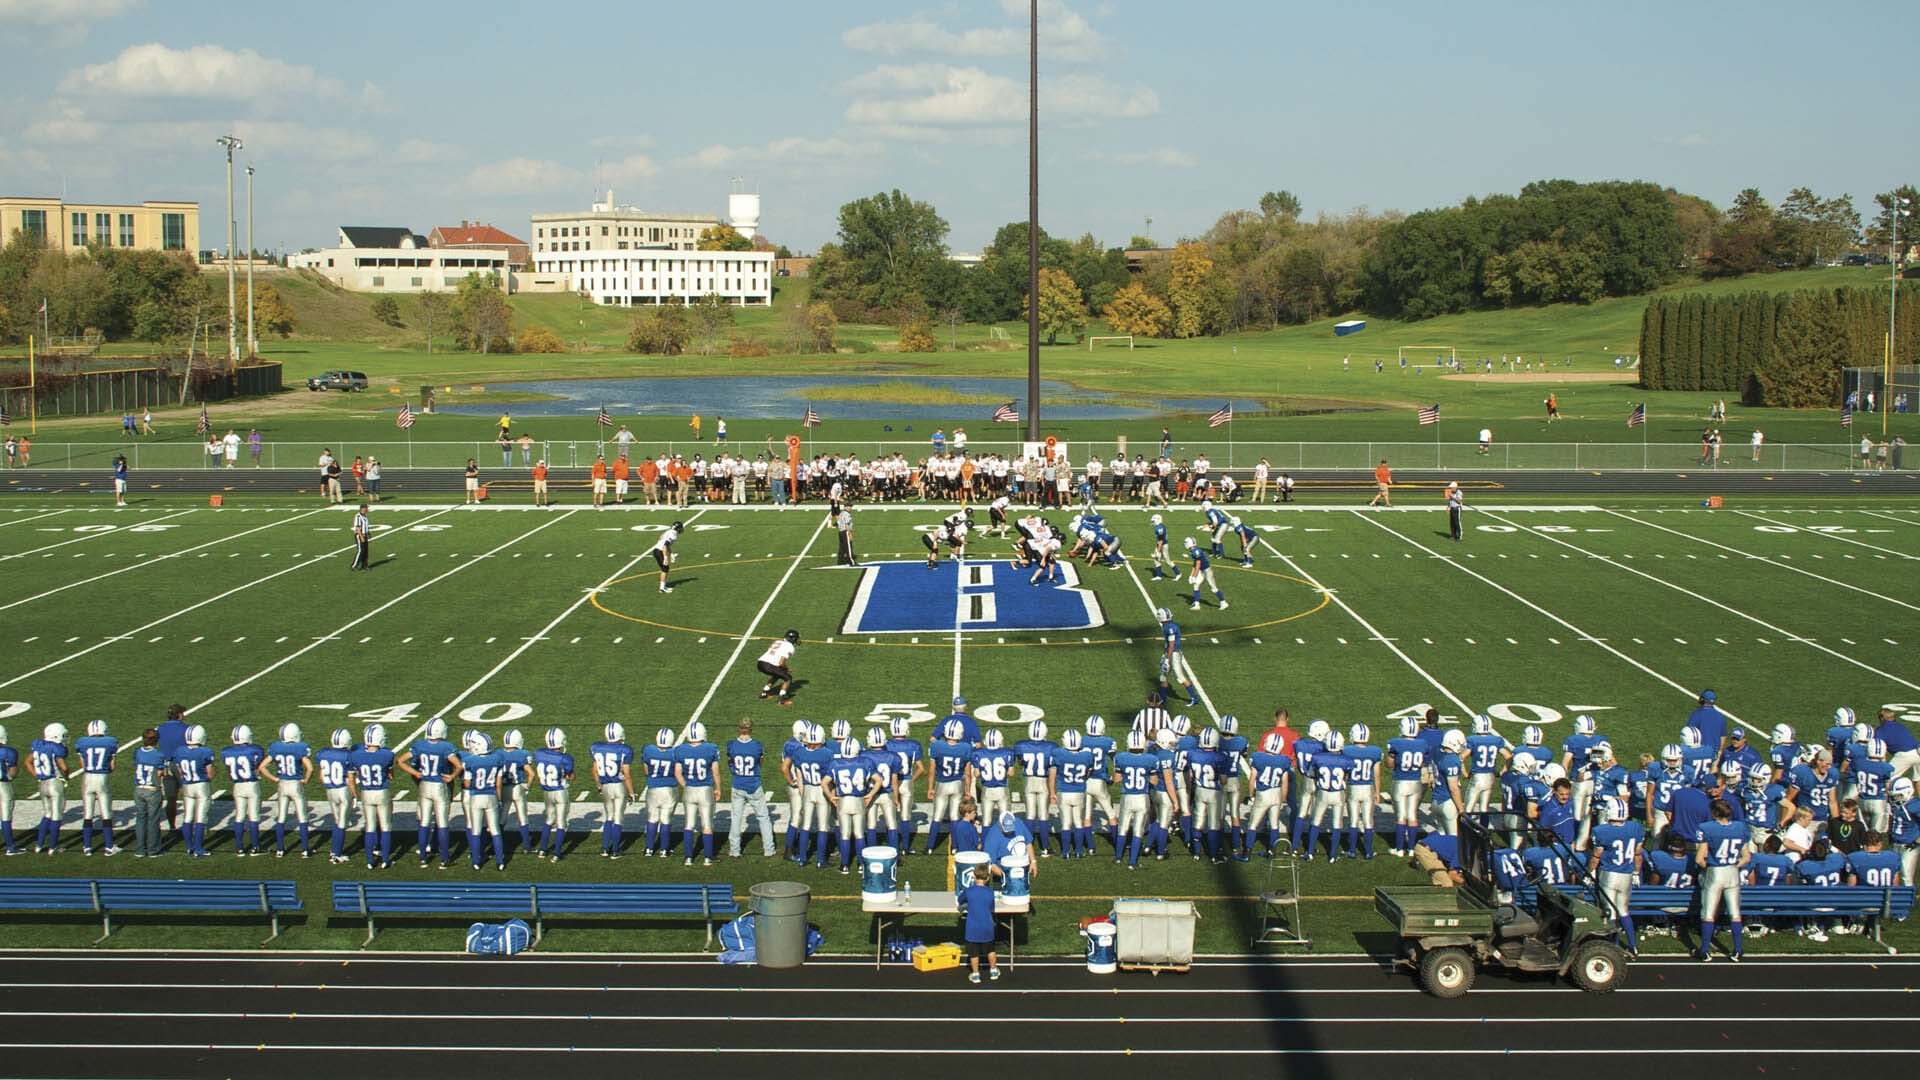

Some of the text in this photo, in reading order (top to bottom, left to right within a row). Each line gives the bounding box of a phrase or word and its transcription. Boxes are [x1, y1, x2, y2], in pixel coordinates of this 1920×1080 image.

[864, 703, 1044, 723] 50
[86, 748, 106, 770] 17
[734, 756, 755, 776] 92
[943, 757, 960, 777] 51
[1023, 753, 1045, 776] 71
[1476, 745, 1497, 768] 33
[360, 764, 383, 787] 93
[475, 768, 497, 789] 84
[650, 759, 671, 778] 77
[684, 758, 707, 780] 76
[801, 763, 821, 785] 66
[980, 757, 1005, 781] 36
[1064, 764, 1087, 783] 52
[1125, 767, 1146, 789] 36
[1259, 766, 1283, 787] 46
[1319, 767, 1345, 790] 33
[1692, 759, 1713, 779] 75
[838, 768, 865, 794] 54
[1613, 838, 1636, 866] 34
[1716, 839, 1742, 864] 45
